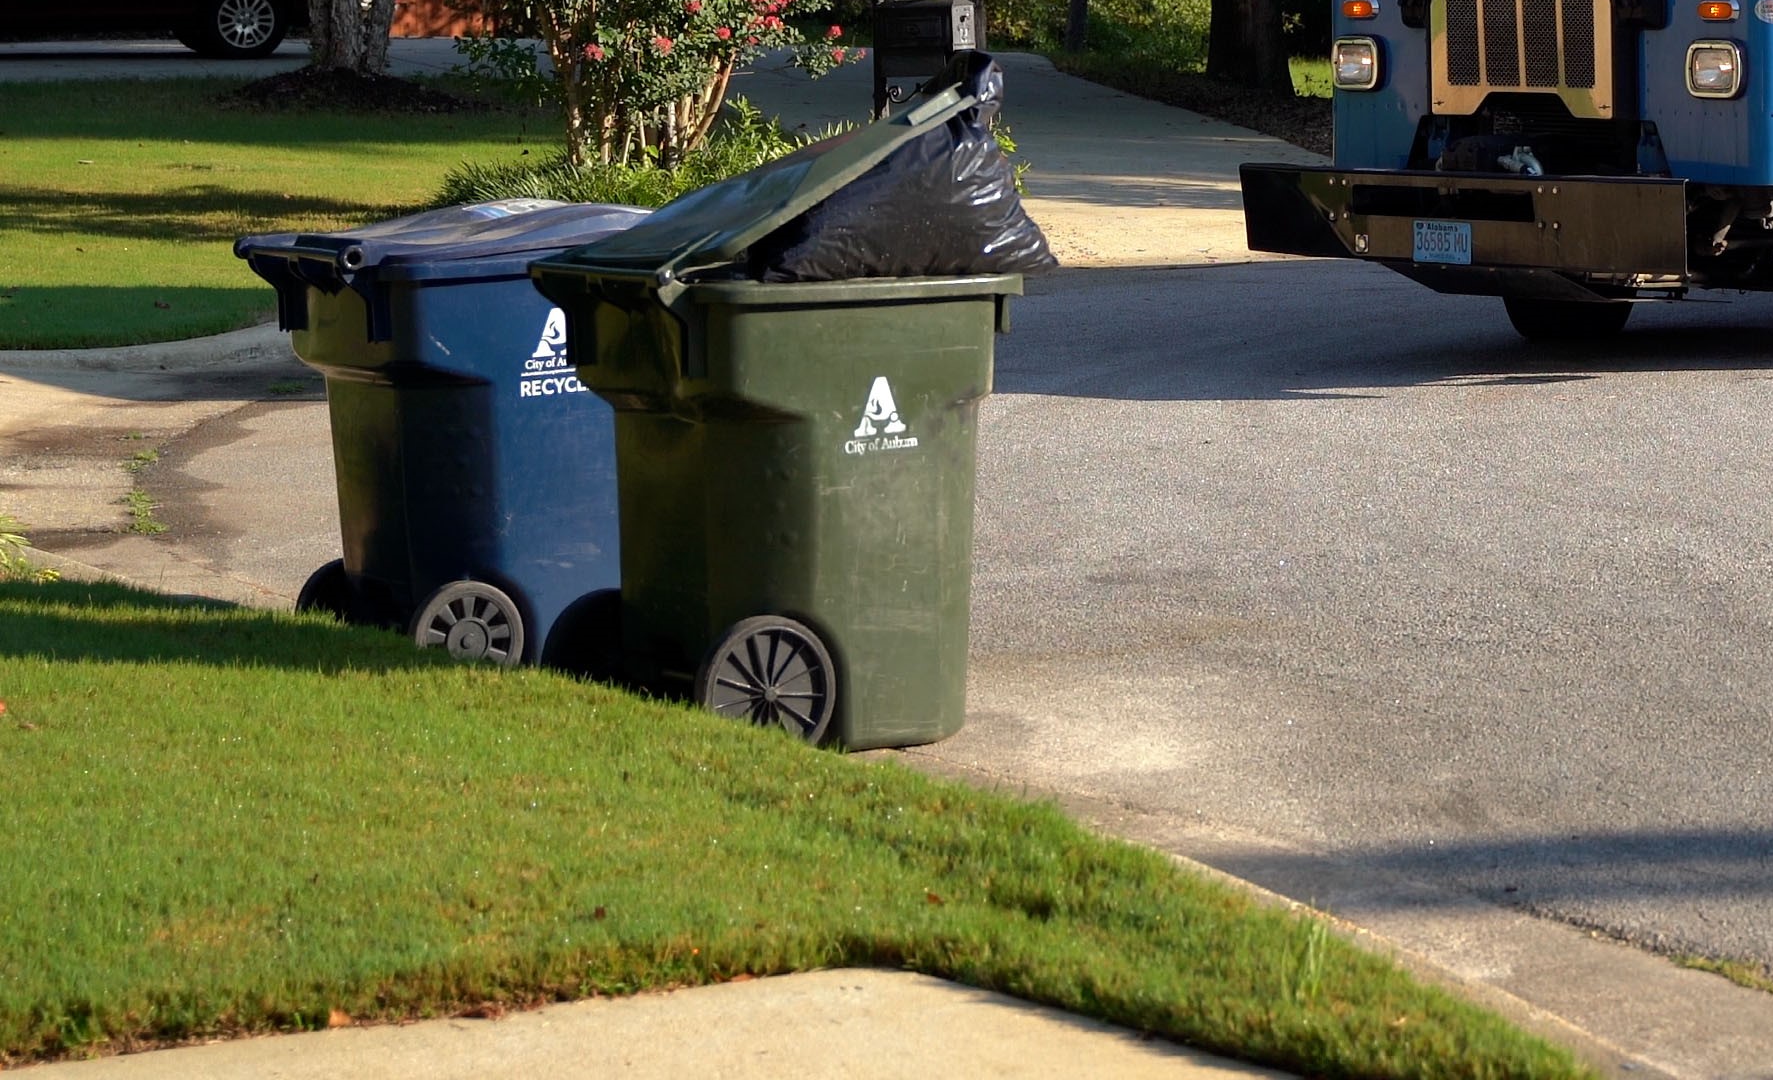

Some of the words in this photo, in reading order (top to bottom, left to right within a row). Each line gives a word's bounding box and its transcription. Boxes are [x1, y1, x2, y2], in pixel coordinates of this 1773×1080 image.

[525, 359, 544, 370] City
[546, 357, 556, 368] of
[520, 376, 590, 397] RECYCL
[845, 440, 866, 455] City
[868, 438, 880, 451] of
